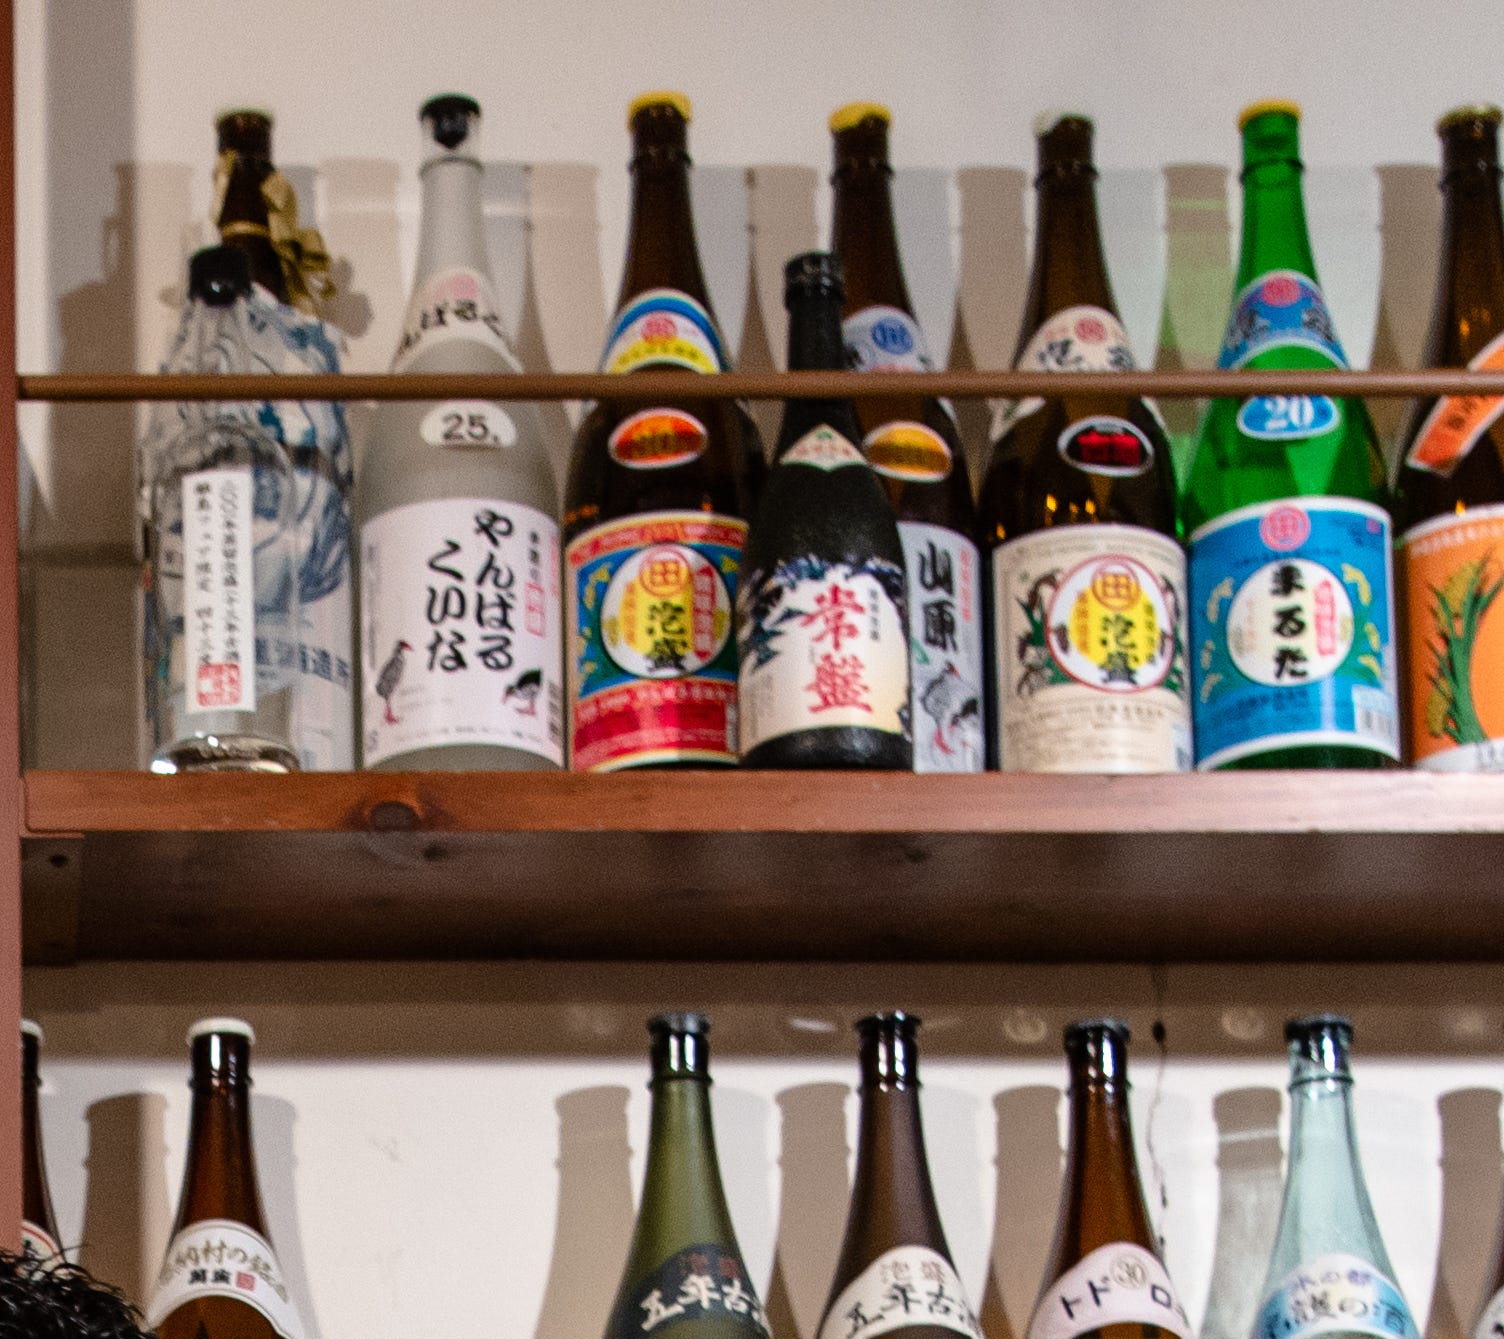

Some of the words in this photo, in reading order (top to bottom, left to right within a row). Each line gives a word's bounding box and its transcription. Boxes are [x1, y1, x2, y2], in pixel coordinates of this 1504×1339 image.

[424, 538, 469, 672] くいな
[471, 507, 517, 672] やんばる
